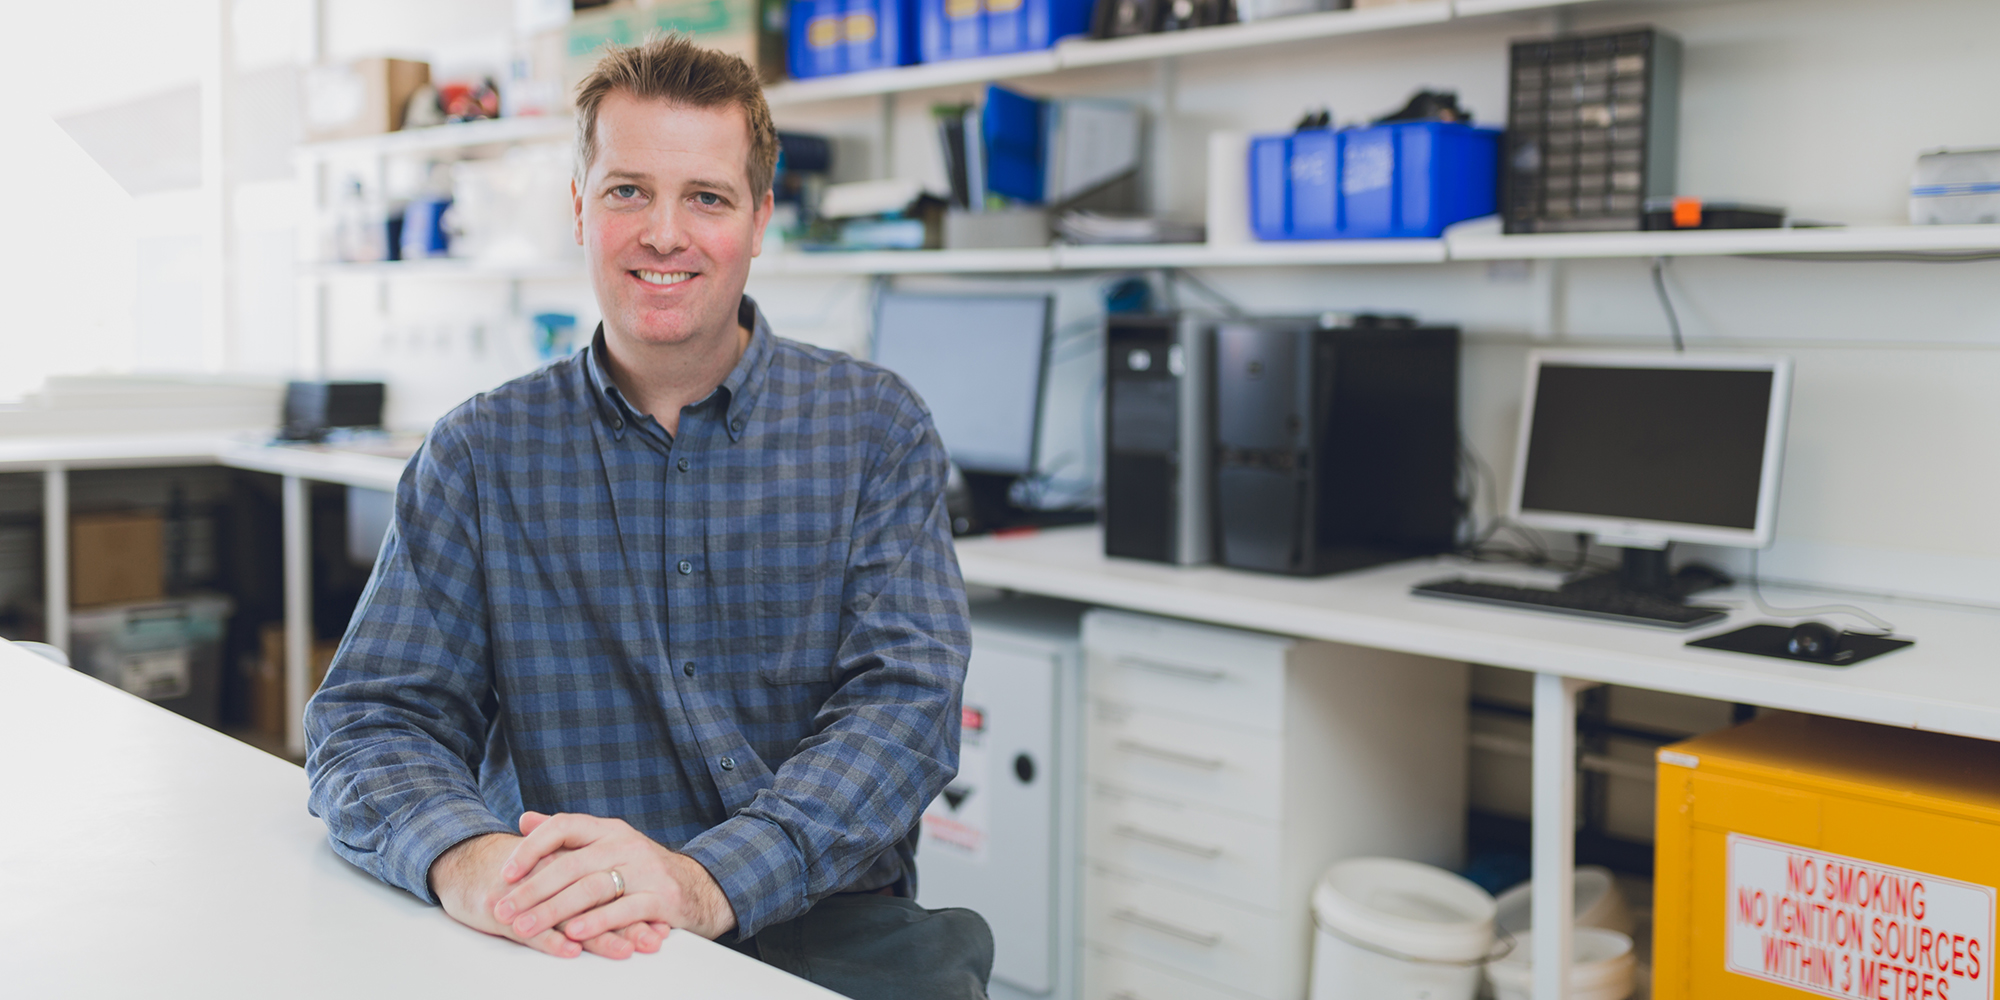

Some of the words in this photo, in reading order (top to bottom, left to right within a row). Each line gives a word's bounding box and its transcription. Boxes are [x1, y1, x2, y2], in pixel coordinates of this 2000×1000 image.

[1786, 855, 1817, 896] NO
[1823, 863, 1925, 921] SMOKING
[1737, 885, 1768, 928] NO
[1772, 893, 1863, 952] IGNITION
[1871, 917, 1980, 980] SOURCES
[1762, 933, 1834, 988] WITHIN
[1842, 953, 1854, 993] 3
